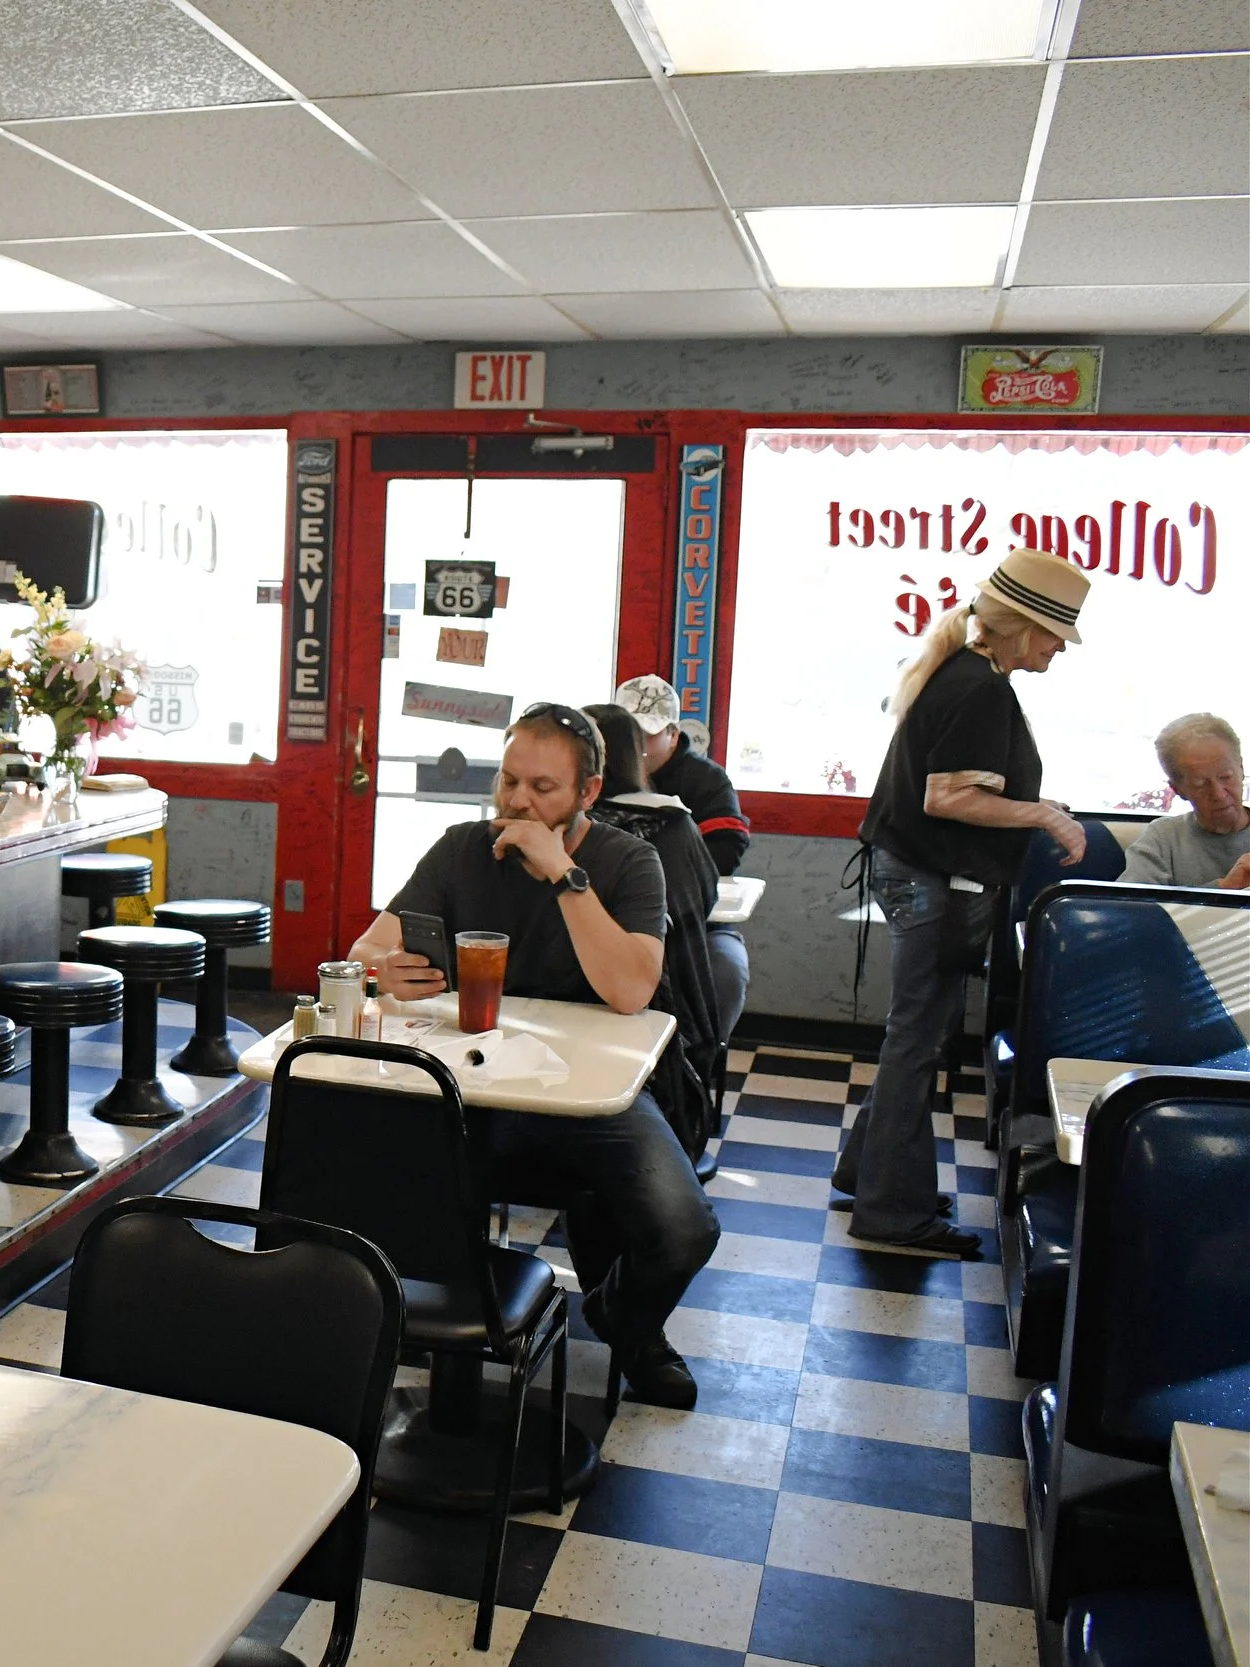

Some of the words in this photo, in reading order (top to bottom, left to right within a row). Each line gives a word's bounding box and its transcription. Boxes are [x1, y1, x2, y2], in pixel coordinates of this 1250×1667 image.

[470, 354, 532, 402] EXIT
[298, 451, 331, 467] Ford
[295, 487, 326, 694] SERVICE
[442, 586, 474, 608] 66
[681, 484, 712, 712] CORVETTE
